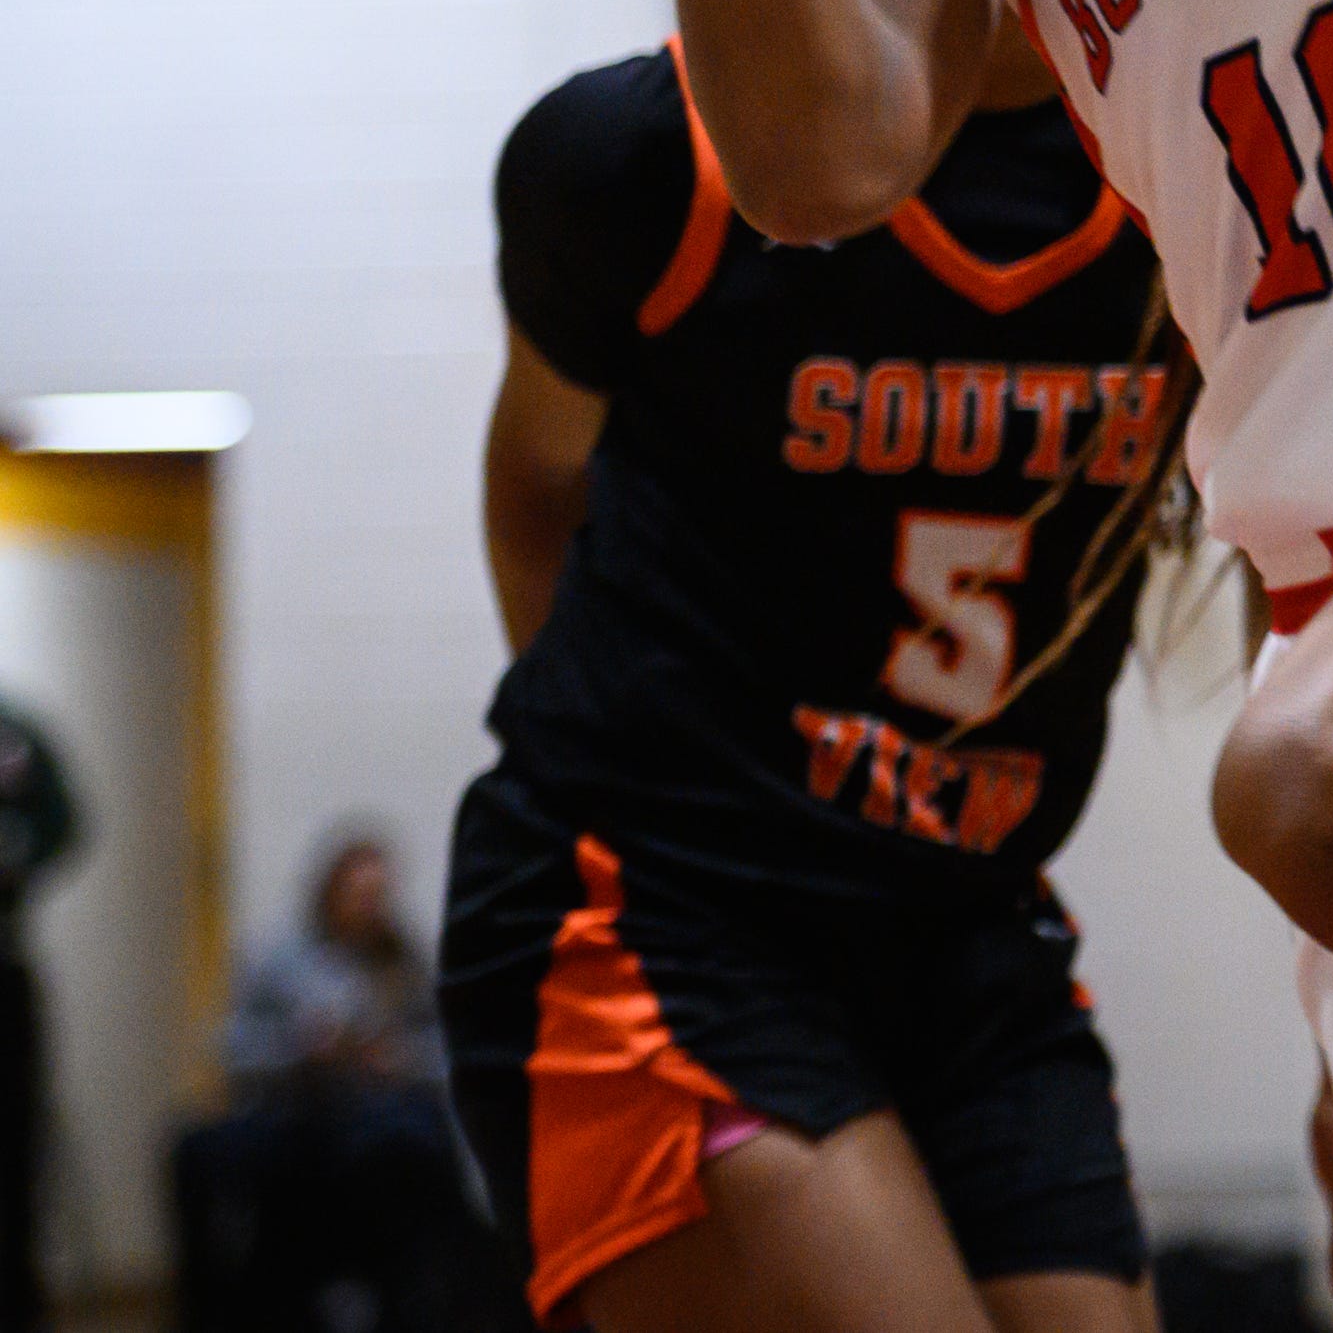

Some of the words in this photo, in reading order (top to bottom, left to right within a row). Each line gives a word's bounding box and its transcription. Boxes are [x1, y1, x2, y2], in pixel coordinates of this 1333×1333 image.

[782, 354, 1168, 486] SOUTH
[880, 506, 1033, 726] 5
[790, 702, 1046, 854] VIEW
